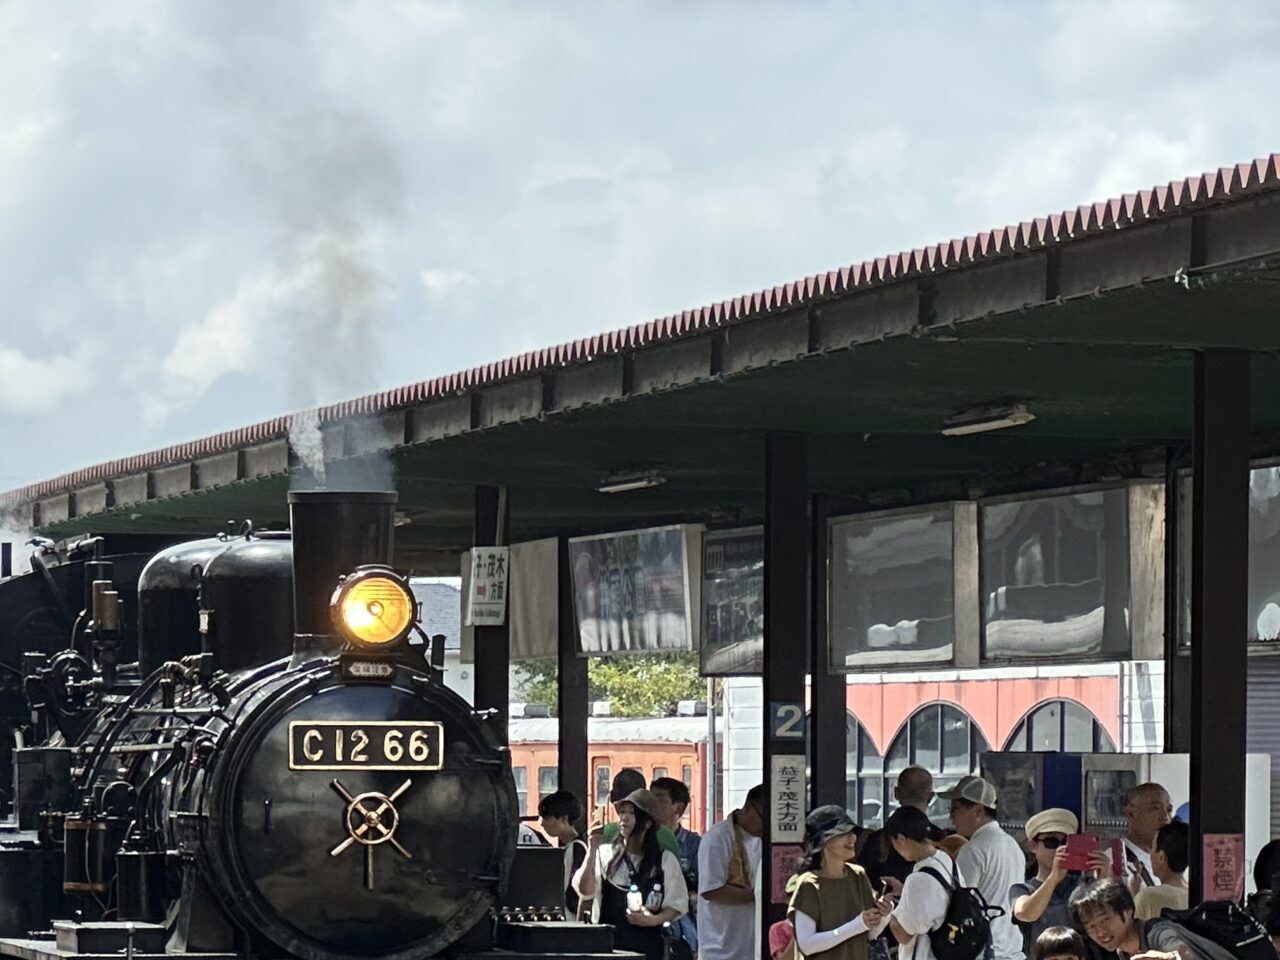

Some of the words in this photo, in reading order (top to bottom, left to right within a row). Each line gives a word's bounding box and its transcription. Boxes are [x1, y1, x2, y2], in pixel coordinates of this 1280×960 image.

[775, 704, 803, 737] 2
[383, 729, 429, 762] 66
[777, 766, 800, 832] 益子・茂木方面
[1213, 847, 1234, 891] 禁煙
